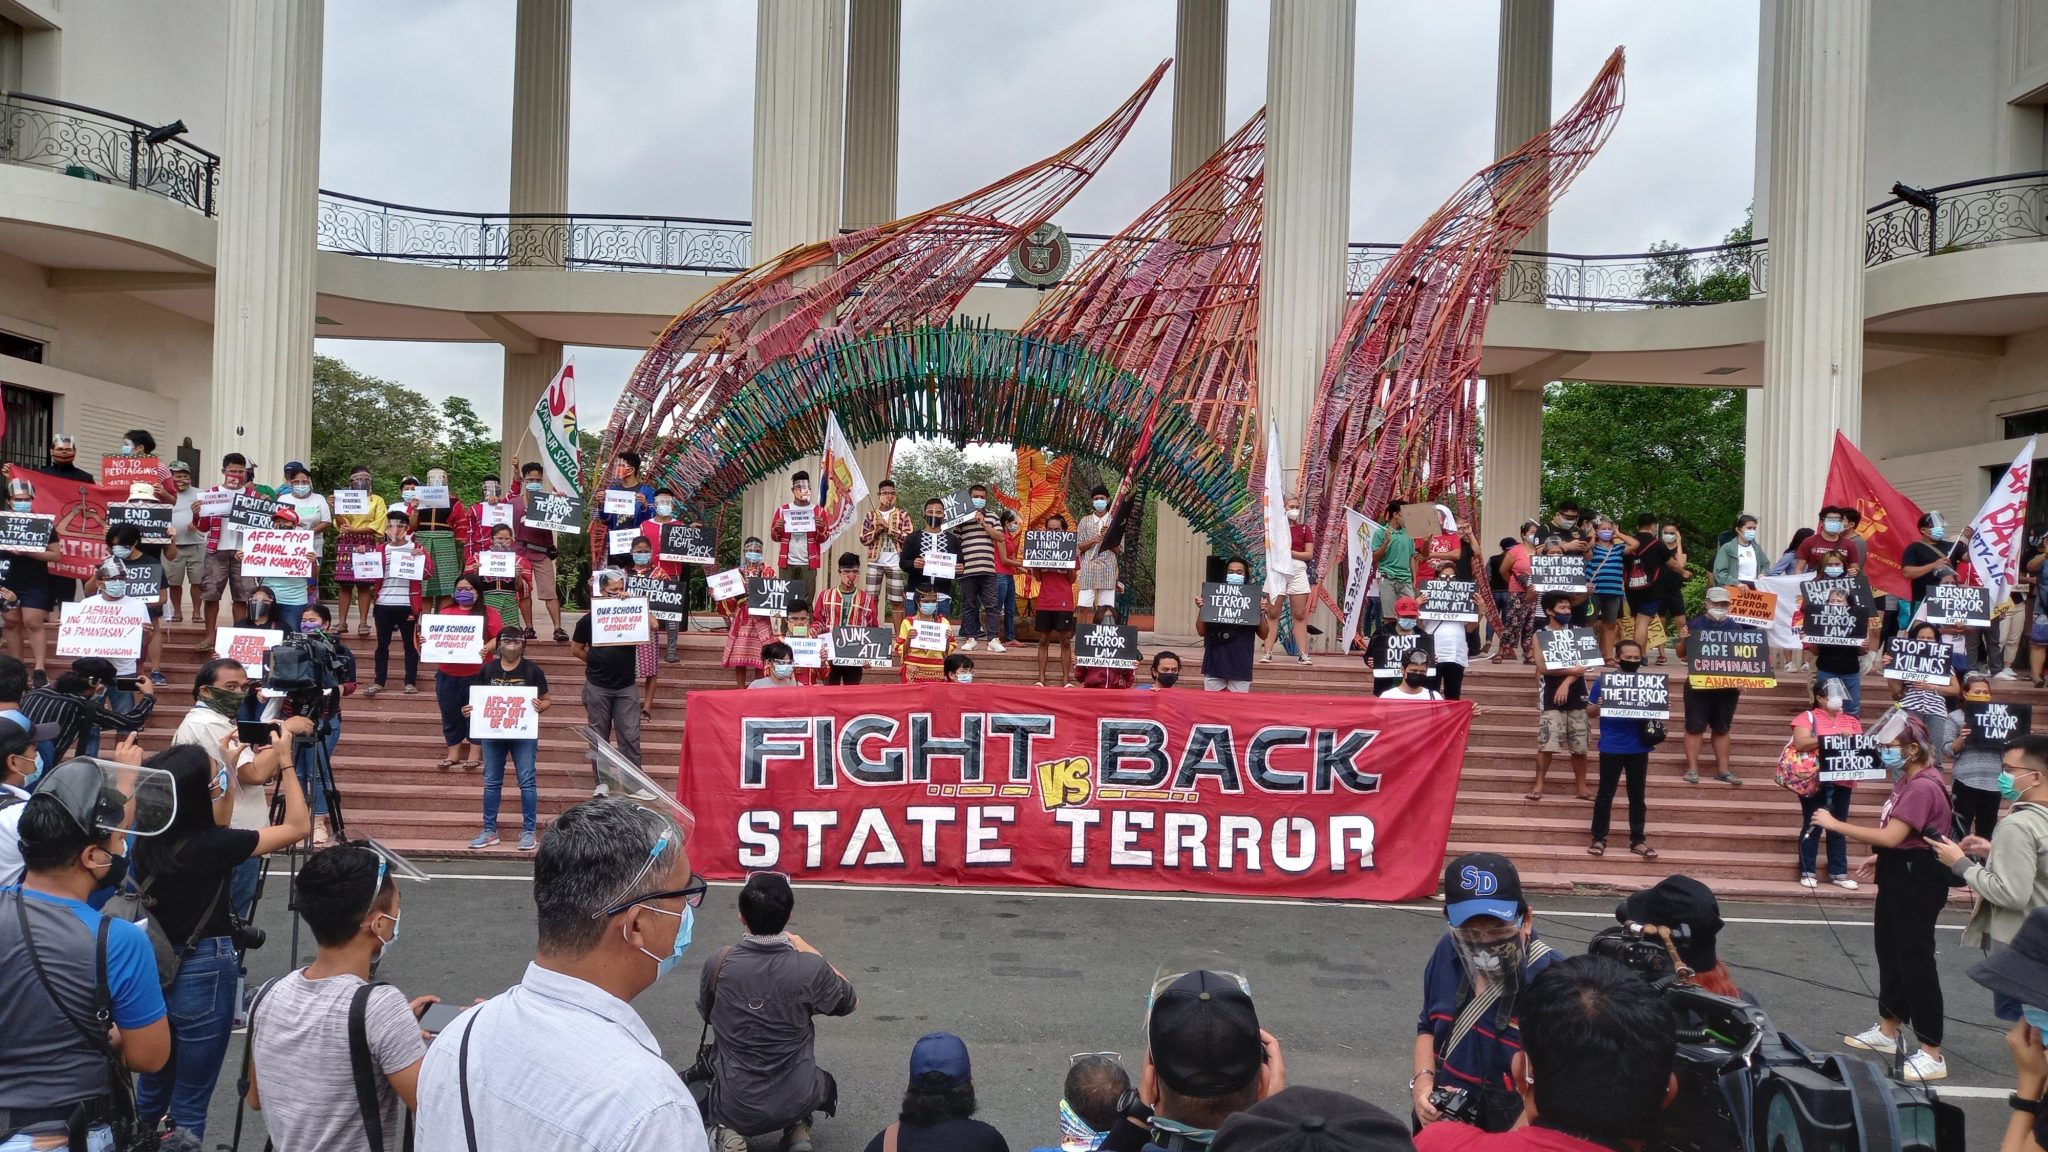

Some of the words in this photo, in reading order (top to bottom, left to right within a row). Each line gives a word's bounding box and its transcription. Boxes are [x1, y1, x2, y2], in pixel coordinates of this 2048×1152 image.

[112, 460, 125, 468] NO
[128, 459, 141, 468] TO
[105, 467, 158, 477] REDTAGGING
[235, 495, 262, 510] FIGHT
[545, 495, 570, 504] JUNK
[125, 508, 150, 519] END
[535, 500, 573, 517] TERROR
[232, 509, 246, 519] THE
[248, 513, 274, 529] TERR
[544, 512, 565, 524] LAW
[8, 524, 28, 532] THE
[0, 530, 46, 541] ATTACKS
[248, 531, 310, 543] AFP-PNP
[668, 537, 694, 548] FIGHT
[1036, 541, 1060, 549] HINDI
[60, 539, 111, 559] ATRIB
[252, 543, 288, 555] BAWAL
[292, 547, 308, 556] SA
[687, 544, 713, 558] BACK
[1025, 549, 1073, 560] PASISMO!
[243, 555, 266, 567] MGA
[269, 557, 312, 571] KAMPUS!
[1532, 556, 1561, 566] FIGHT
[1562, 556, 1585, 566] BACK
[1530, 566, 1548, 576] THE
[1548, 566, 1585, 576] TERROR
[131, 583, 158, 594] BACK
[757, 579, 790, 595] JUNK
[1215, 584, 1243, 596] JUNK
[1426, 580, 1447, 590] STOP
[1448, 581, 1476, 592] STATE
[644, 589, 682, 605] TERROR
[1936, 586, 1980, 599] IBASURA
[1209, 595, 1251, 609] TERROR
[1425, 601, 1449, 611] JUNK
[1731, 599, 1769, 610] TERROR
[1939, 598, 1983, 612] TERROR
[597, 607, 611, 615] OUR
[612, 606, 643, 614] SCHOOLS
[1749, 608, 1772, 618] NOW
[1821, 605, 1851, 616] JUNK
[1945, 610, 1968, 619] LAW
[628, 615, 642, 623] WAR
[1811, 614, 1856, 627] TERROR
[62, 627, 71, 637] SA
[445, 625, 476, 633] SCHOOLS
[1092, 625, 1119, 637] JUNK
[1553, 630, 1574, 640] END
[836, 627, 871, 648] JUNK
[1084, 635, 1125, 648] TERROR
[1388, 634, 1421, 650] OUST
[1700, 630, 1763, 643] ACTIVISTS
[435, 641, 467, 649] GROUNDS!
[1548, 640, 1576, 651] STATE
[1701, 644, 1728, 656] ARE
[1734, 645, 1758, 658] NOT
[1891, 639, 1926, 654] STOP
[1927, 642, 1950, 658] THE
[1094, 647, 1117, 658] LAW
[1384, 661, 1402, 669] JUN
[1694, 658, 1766, 673] CRIMINALS!
[1895, 654, 1945, 674] KILLINGS
[1605, 673, 1635, 687] FIGHT
[1637, 674, 1665, 689] BACK
[485, 696, 525, 707] AFP-PNP
[1601, 688, 1622, 700] THE
[1623, 688, 1668, 704] TERROR
[483, 707, 507, 718] KEEP
[508, 707, 526, 718] OUT
[1986, 704, 2008, 716] JUNK
[503, 718, 519, 729] UP!
[1974, 714, 2018, 730] TERROR
[1985, 727, 2008, 739] LAW
[1824, 735, 1853, 749] FIGHT
[1855, 734, 1878, 749] BAC
[740, 712, 1055, 790] FIGHT
[1097, 717, 1383, 795] BACK
[1839, 749, 1860, 758] THE
[1825, 755, 1873, 771] TERROR
[1035, 757, 1093, 812] VS
[736, 805, 1016, 870] STATE
[1054, 807, 1377, 874] TERROR
[1460, 865, 1498, 896] SD
